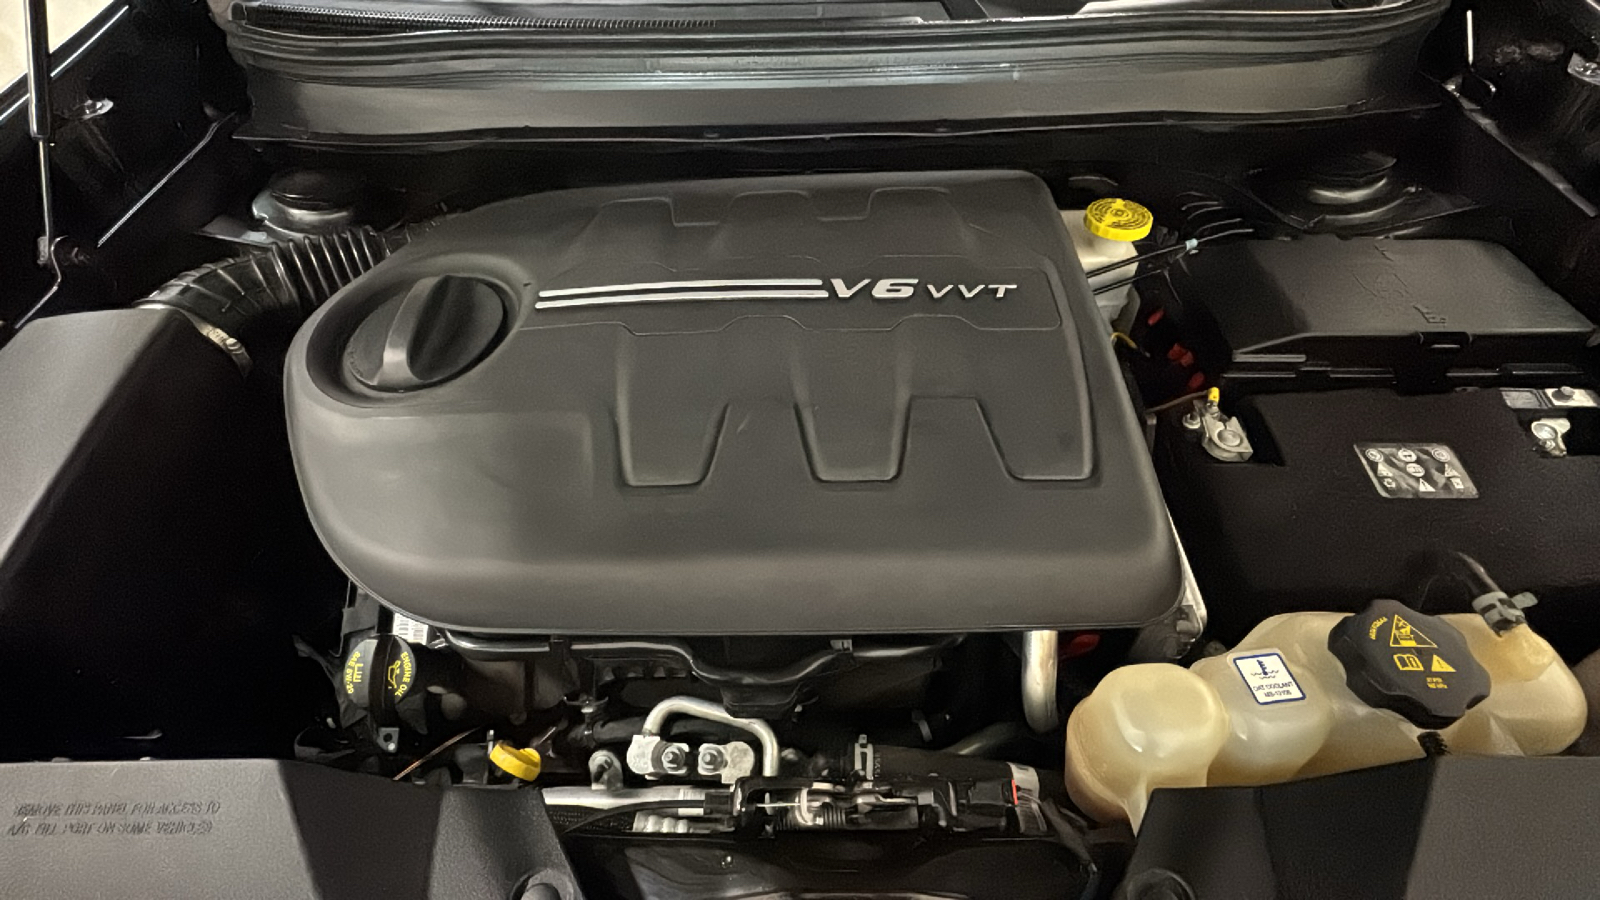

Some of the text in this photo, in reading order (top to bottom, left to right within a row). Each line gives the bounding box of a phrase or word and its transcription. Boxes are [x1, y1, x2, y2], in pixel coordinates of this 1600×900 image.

[829, 278, 1019, 300] V6 VVT
[400, 651, 412, 683] ENGINE
[394, 684, 408, 697] OIL
